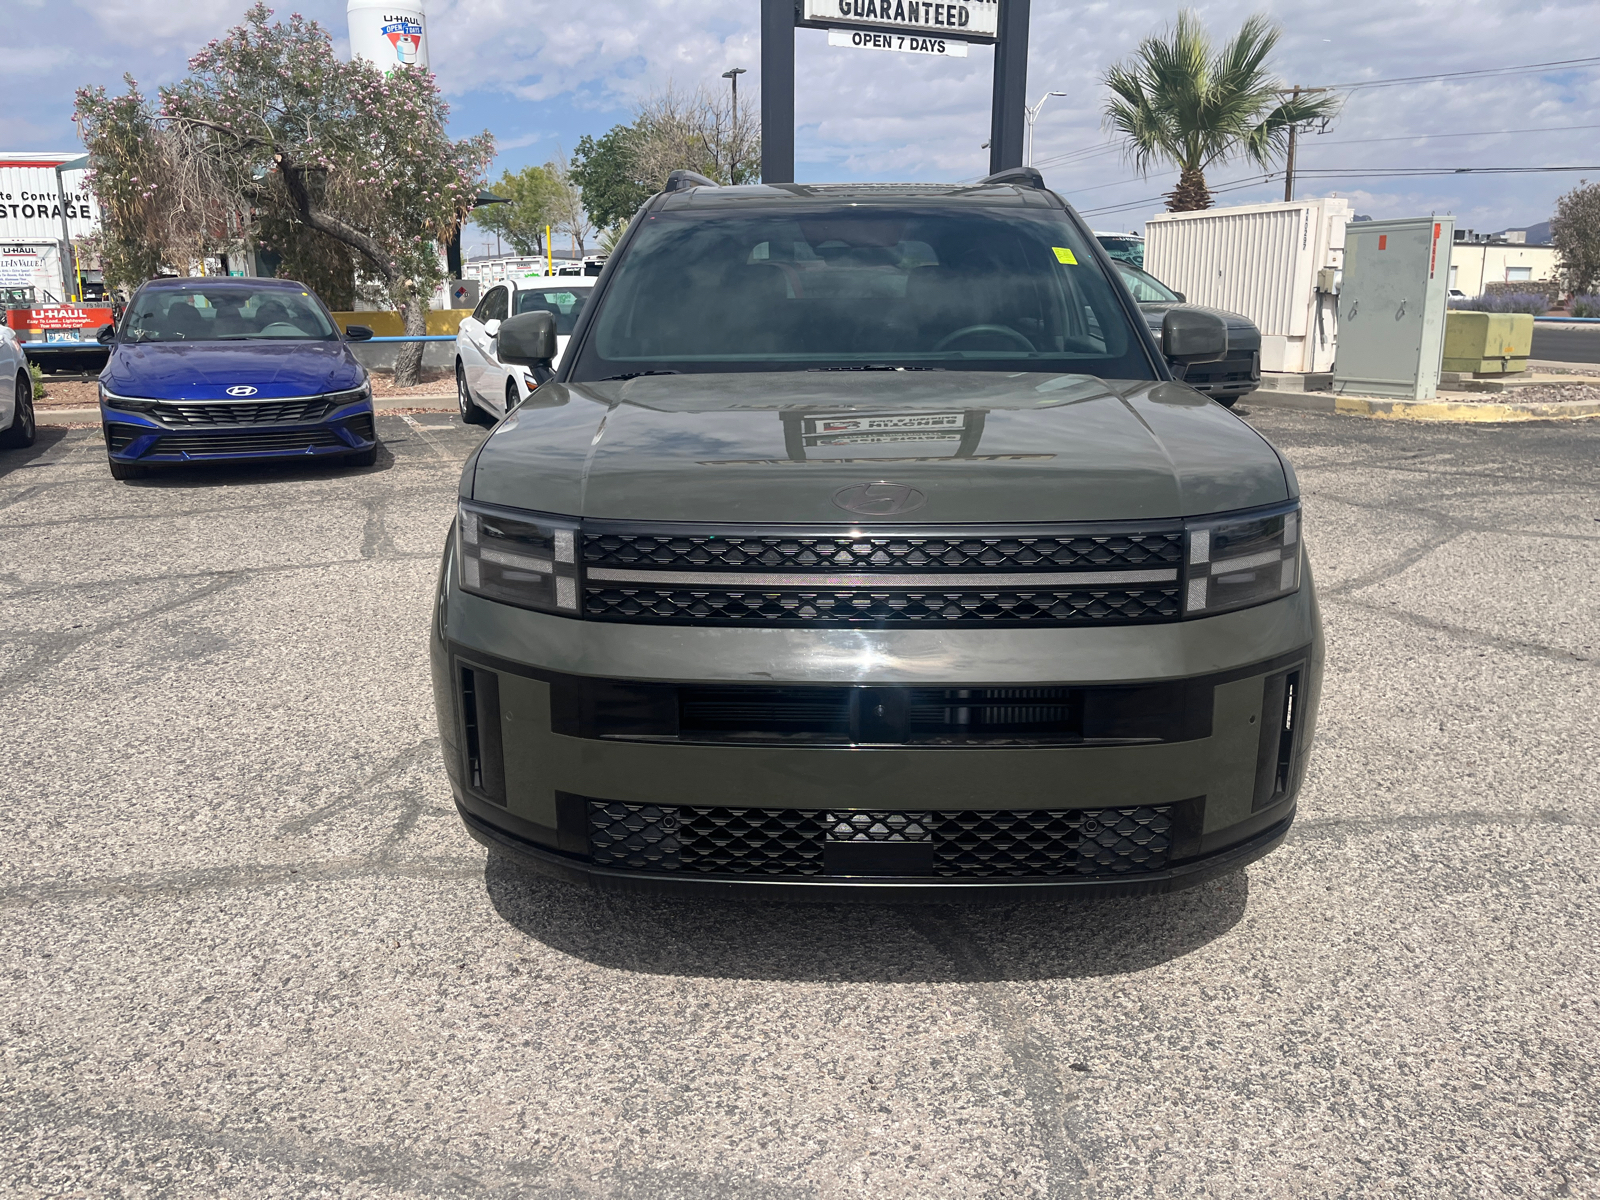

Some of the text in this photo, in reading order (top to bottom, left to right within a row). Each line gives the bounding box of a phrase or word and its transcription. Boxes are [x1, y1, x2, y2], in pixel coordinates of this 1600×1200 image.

[839, 0, 970, 27] GUARANTEED
[384, 15, 420, 25] U-HAUL
[386, 24, 403, 33] OPEN
[852, 32, 946, 53] OPEN 7 DAYS
[0, 204, 91, 219] STORAGE
[32, 309, 87, 318] U-HAUL
